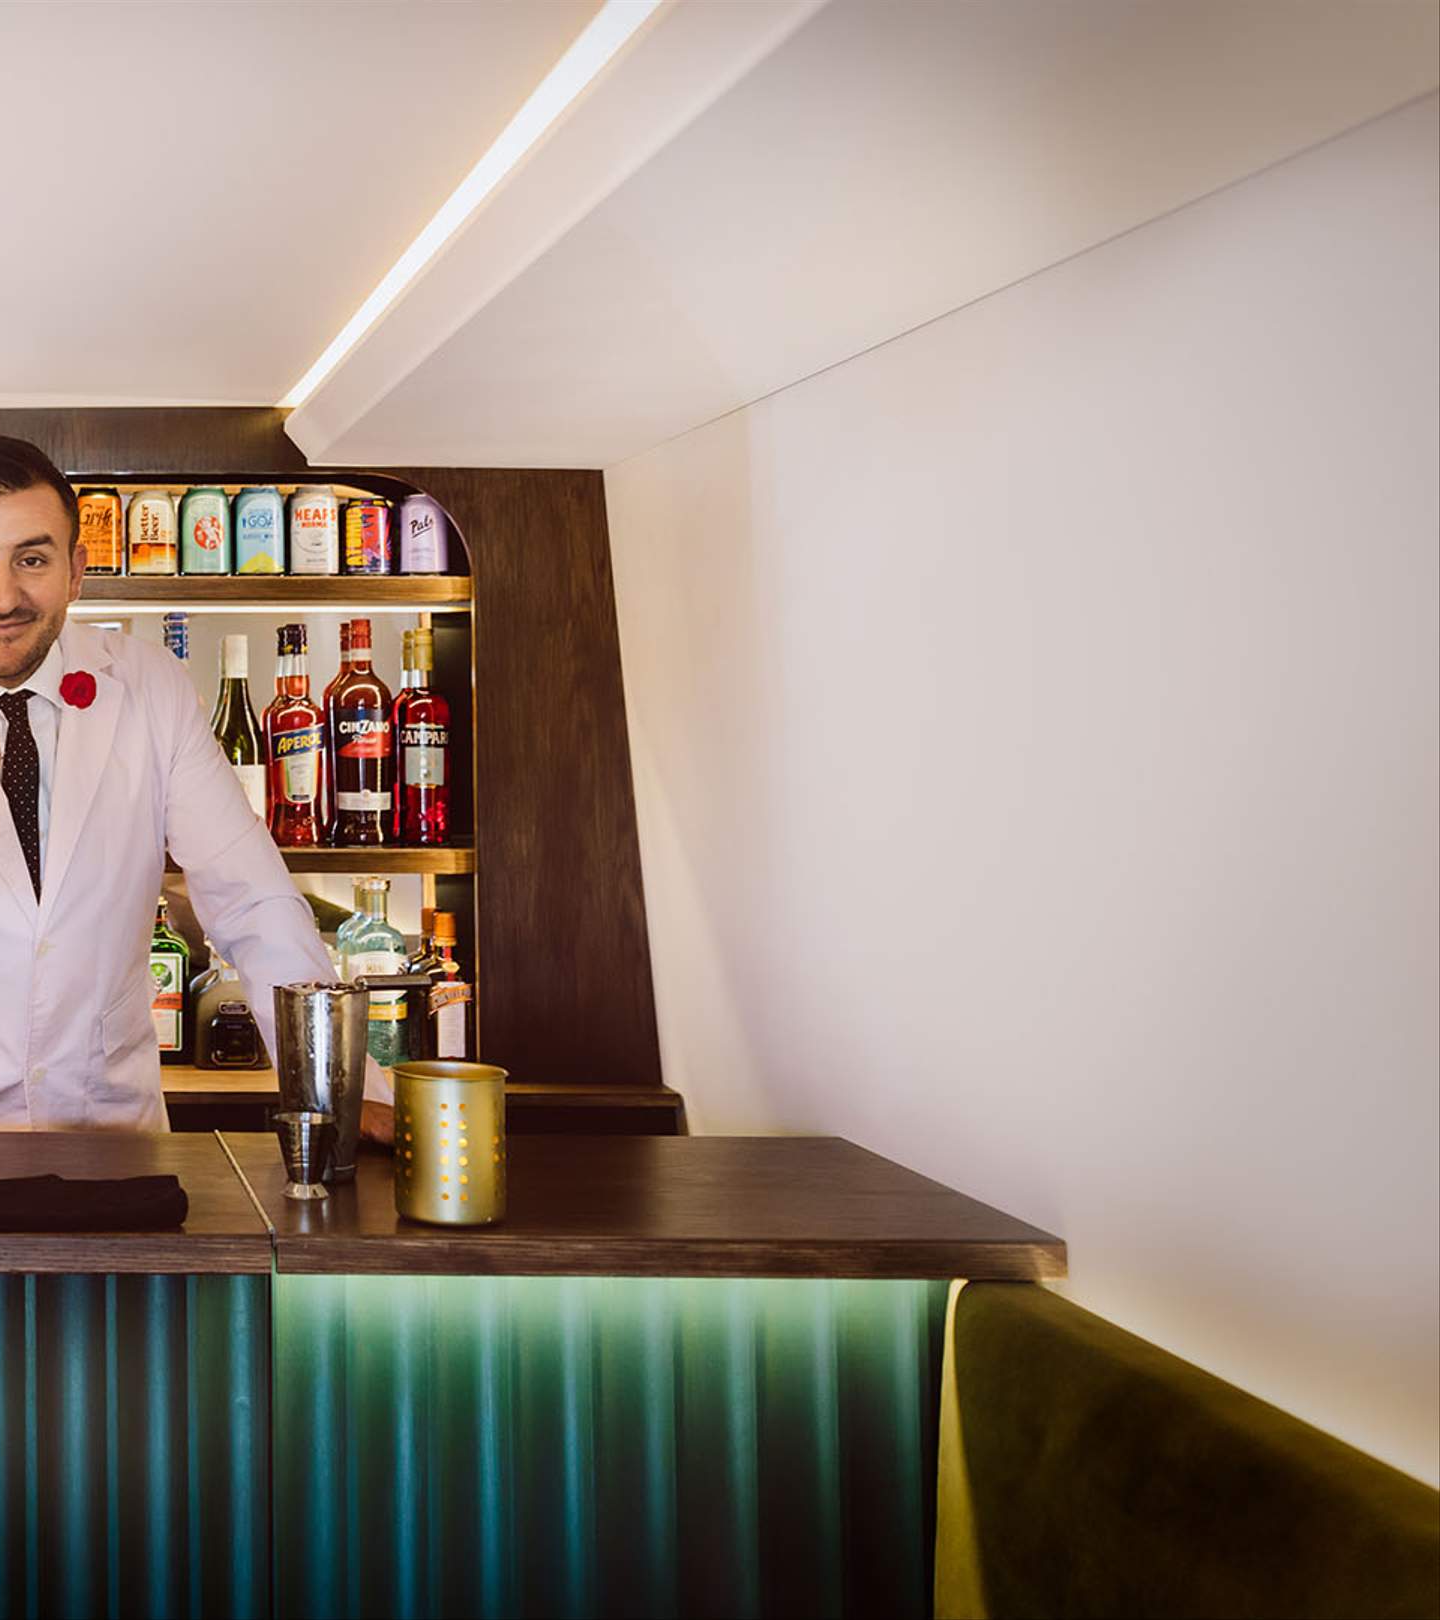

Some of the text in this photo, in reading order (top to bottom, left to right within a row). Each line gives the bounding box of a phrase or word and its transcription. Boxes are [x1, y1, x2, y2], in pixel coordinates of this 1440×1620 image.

[339, 720, 390, 734] CINZANO
[277, 732, 322, 754] APEROL
[400, 730, 448, 744] CAMPARI
